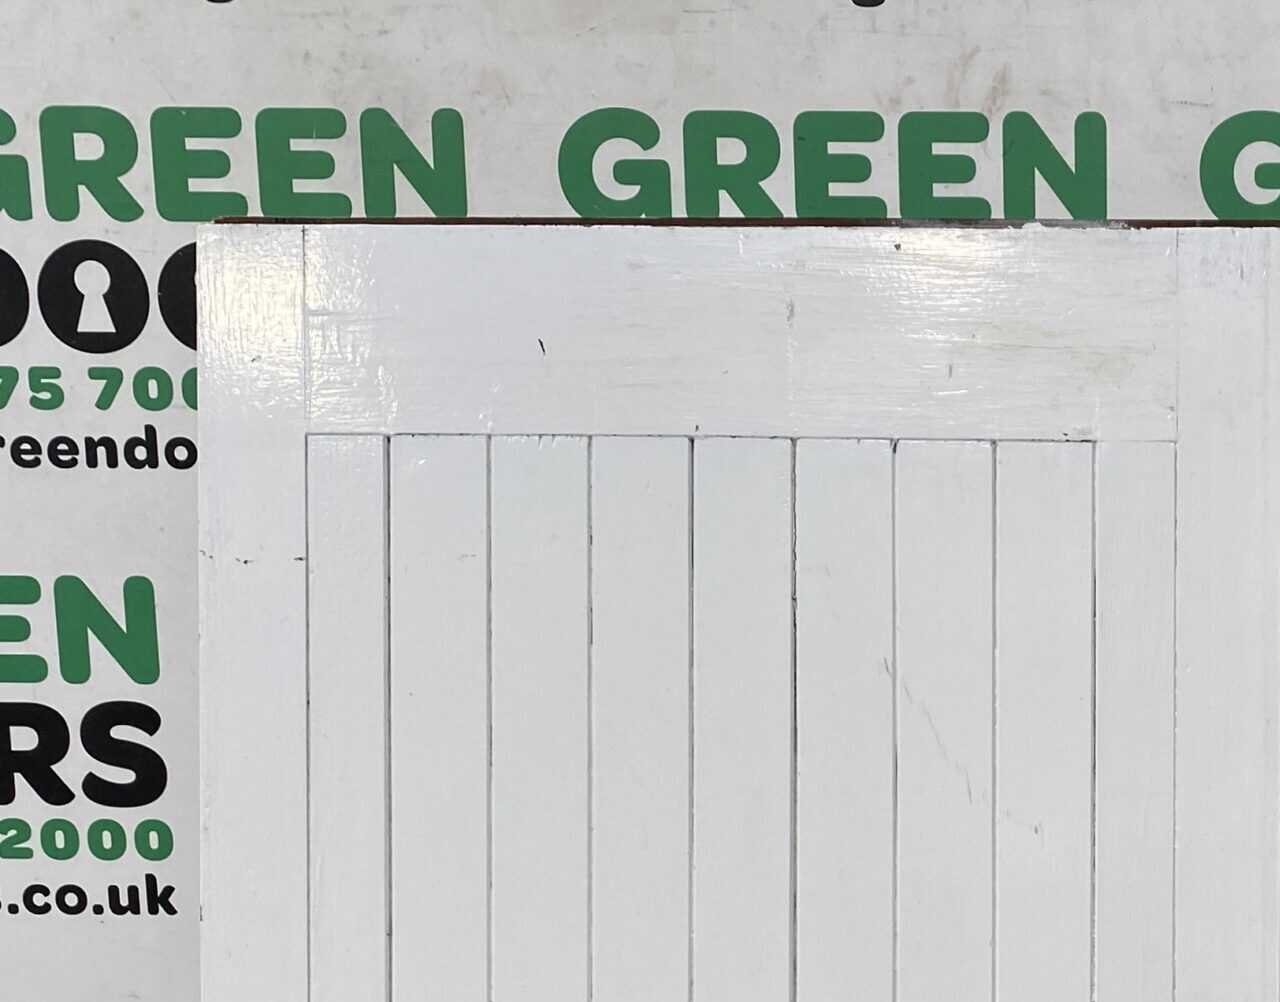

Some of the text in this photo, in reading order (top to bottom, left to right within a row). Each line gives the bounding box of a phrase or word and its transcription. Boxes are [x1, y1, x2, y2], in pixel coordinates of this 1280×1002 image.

[0, 105, 469, 223] REEN
[557, 106, 1108, 223] GREEN
[0, 424, 198, 470] eendo
[0, 817, 174, 862] 2000
